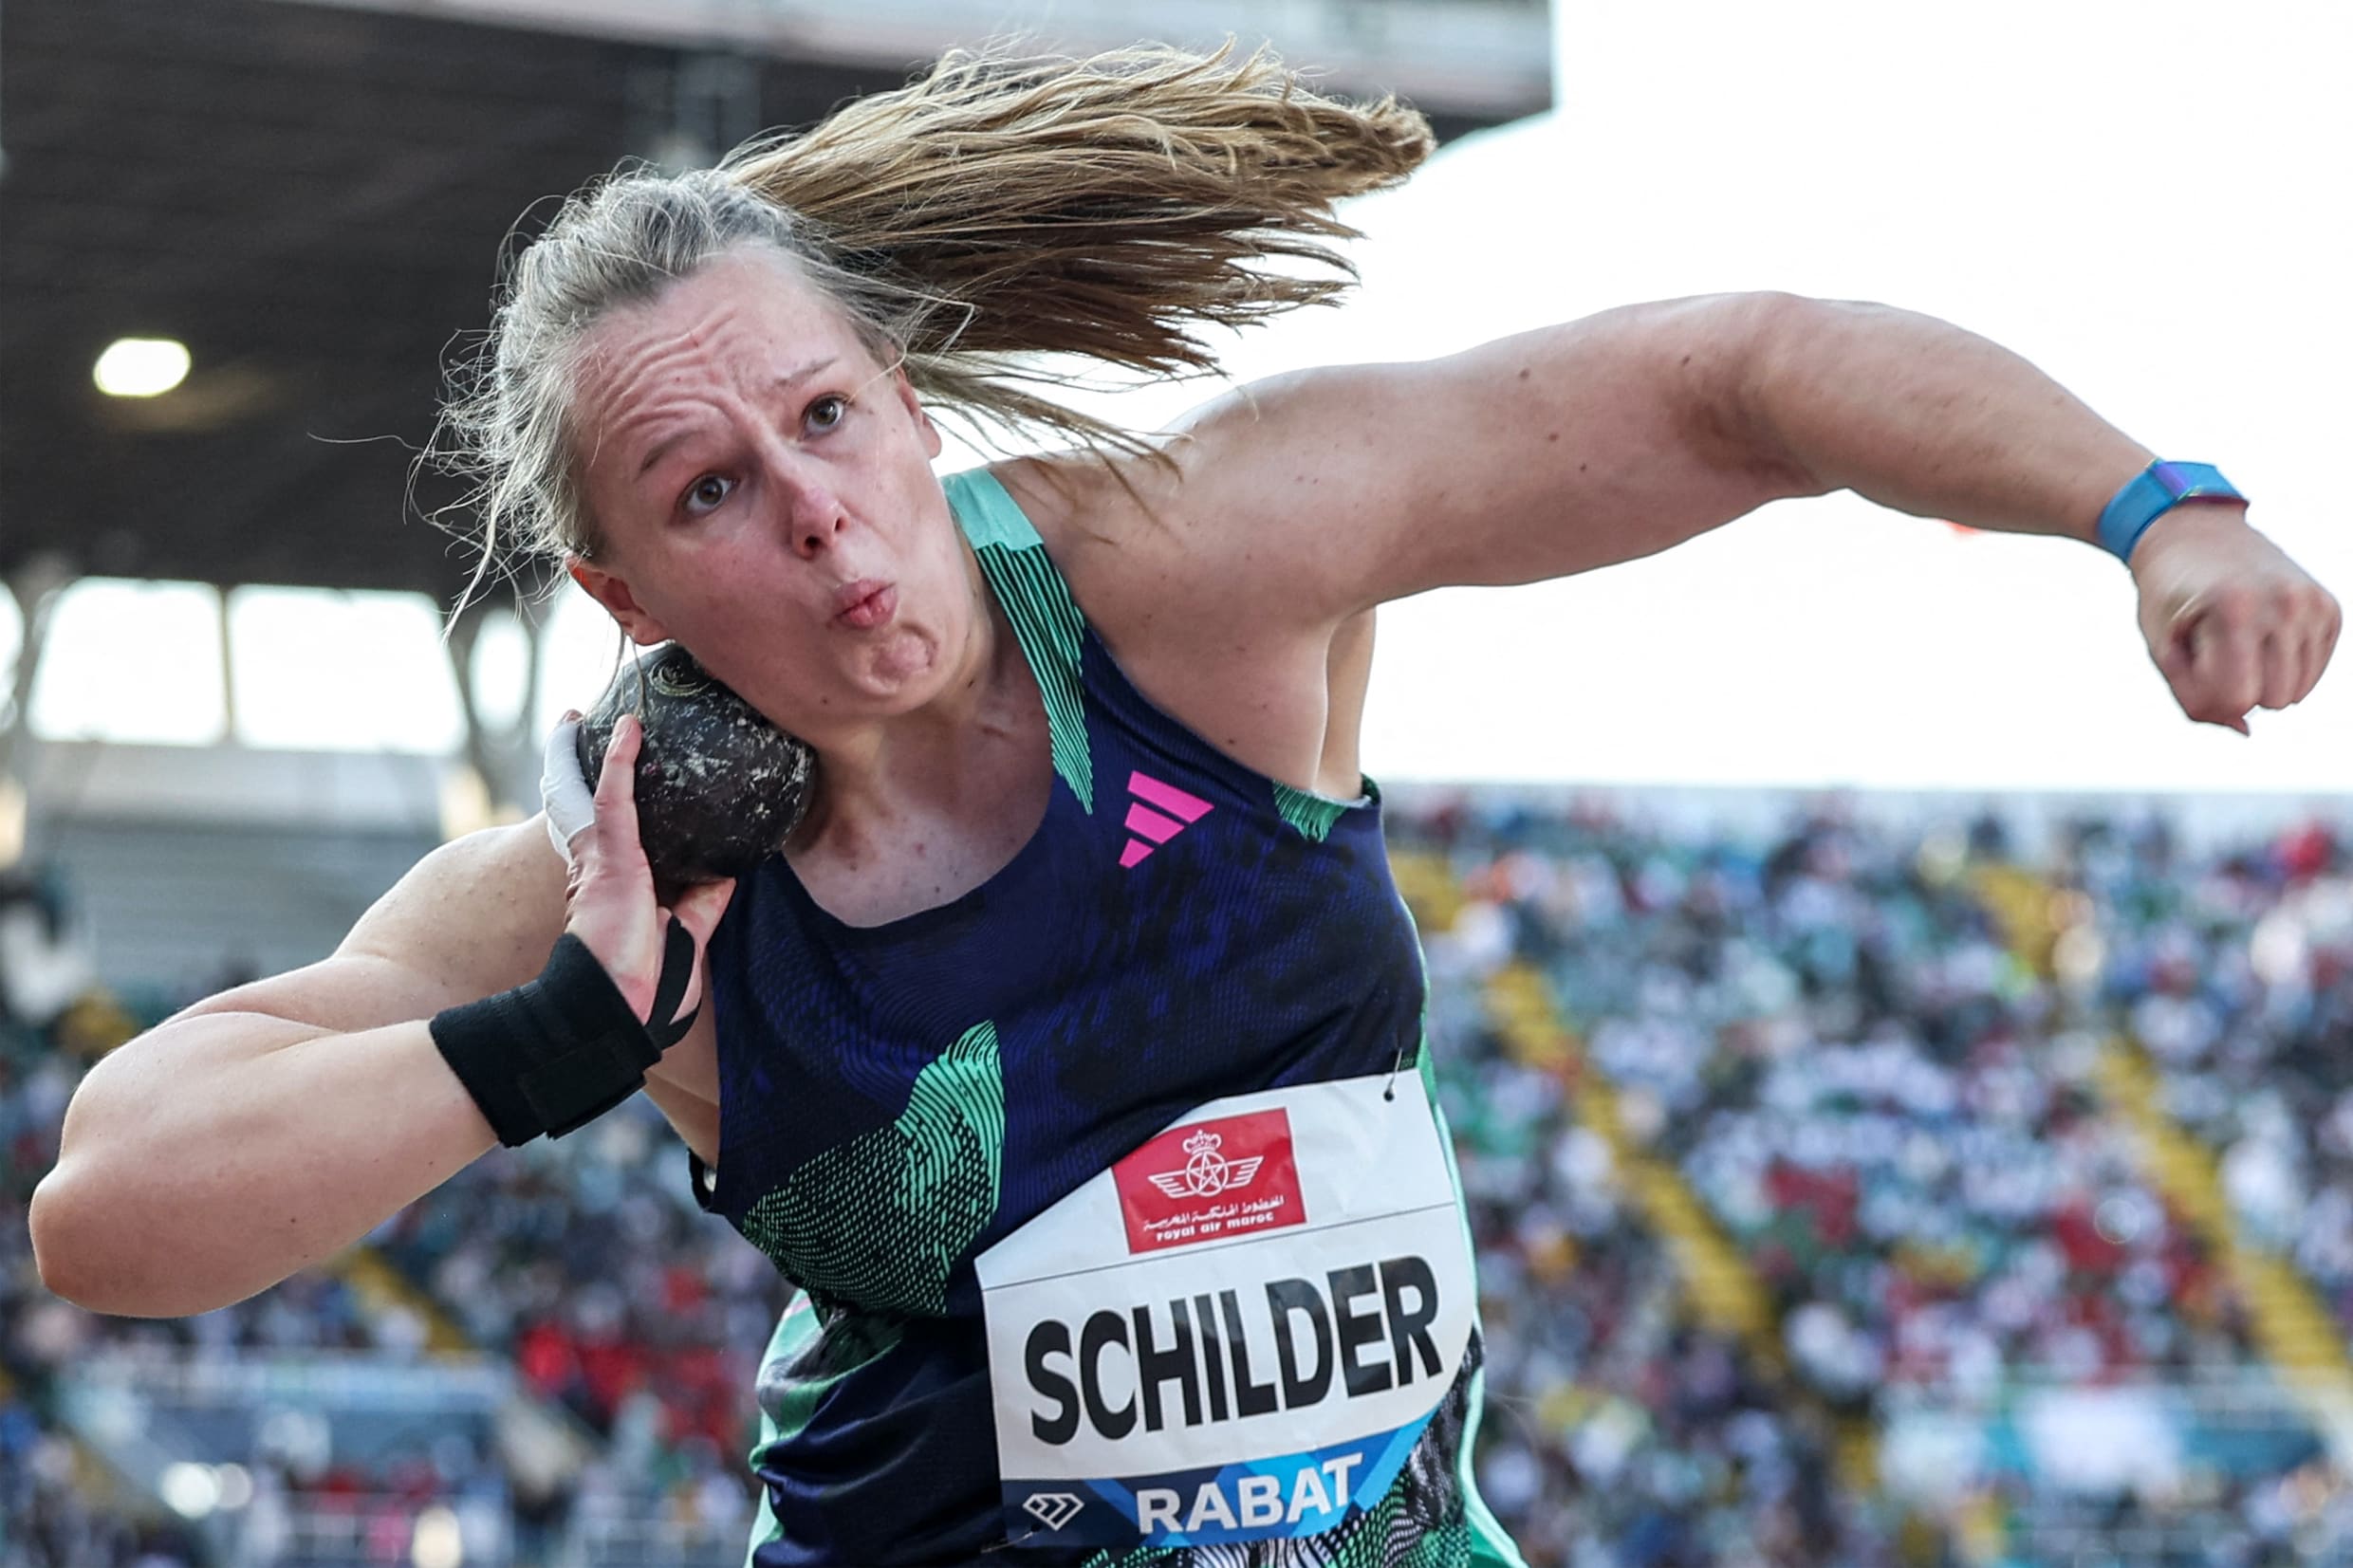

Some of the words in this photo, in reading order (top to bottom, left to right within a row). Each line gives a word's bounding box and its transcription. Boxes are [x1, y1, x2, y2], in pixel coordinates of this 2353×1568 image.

[1156, 1225, 1195, 1242] royal
[1200, 1221, 1221, 1233] air
[1226, 1211, 1274, 1228] maroc
[1024, 1255, 1444, 1446] SCHILDER
[1138, 1452, 1363, 1535] RABAT
